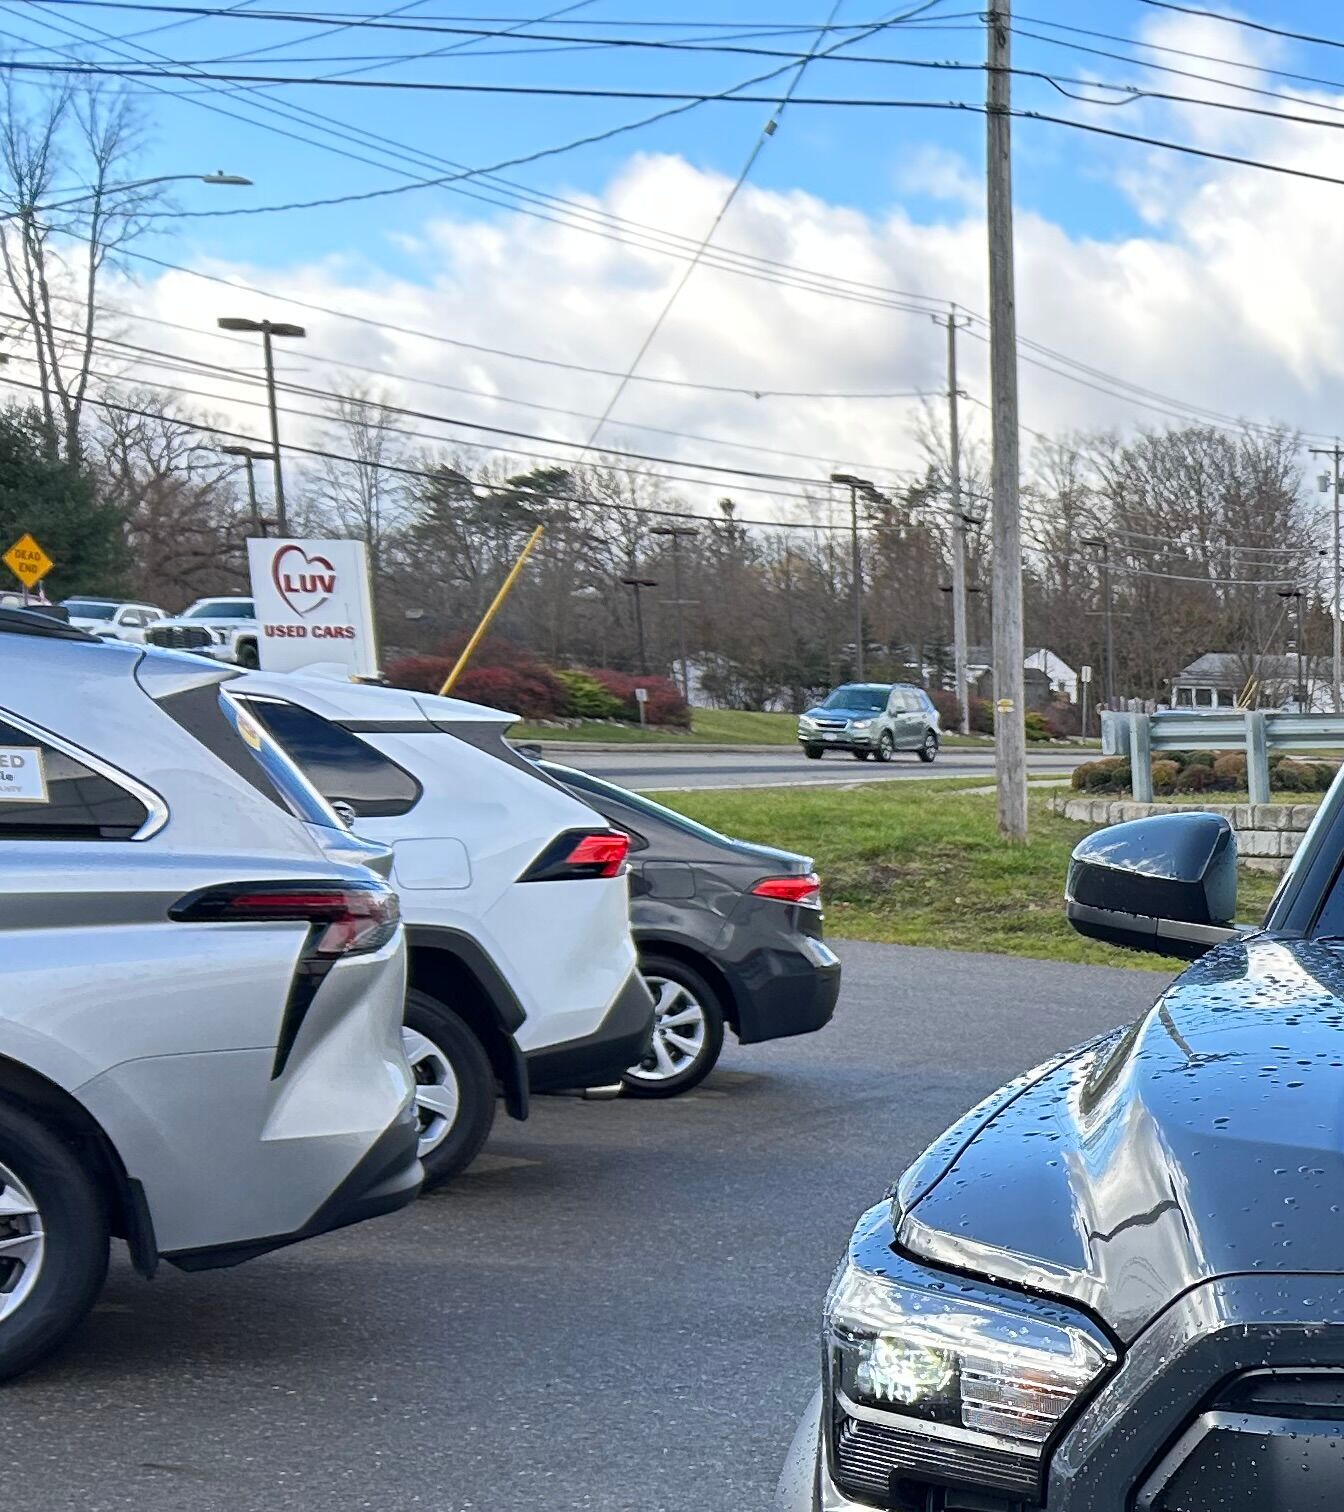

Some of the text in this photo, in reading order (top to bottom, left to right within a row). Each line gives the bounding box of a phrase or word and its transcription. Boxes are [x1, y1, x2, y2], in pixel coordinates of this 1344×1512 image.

[15, 549, 41, 561] DEAD
[18, 562, 38, 574] END
[283, 574, 336, 593] LUV
[264, 624, 356, 639] USED CARS
